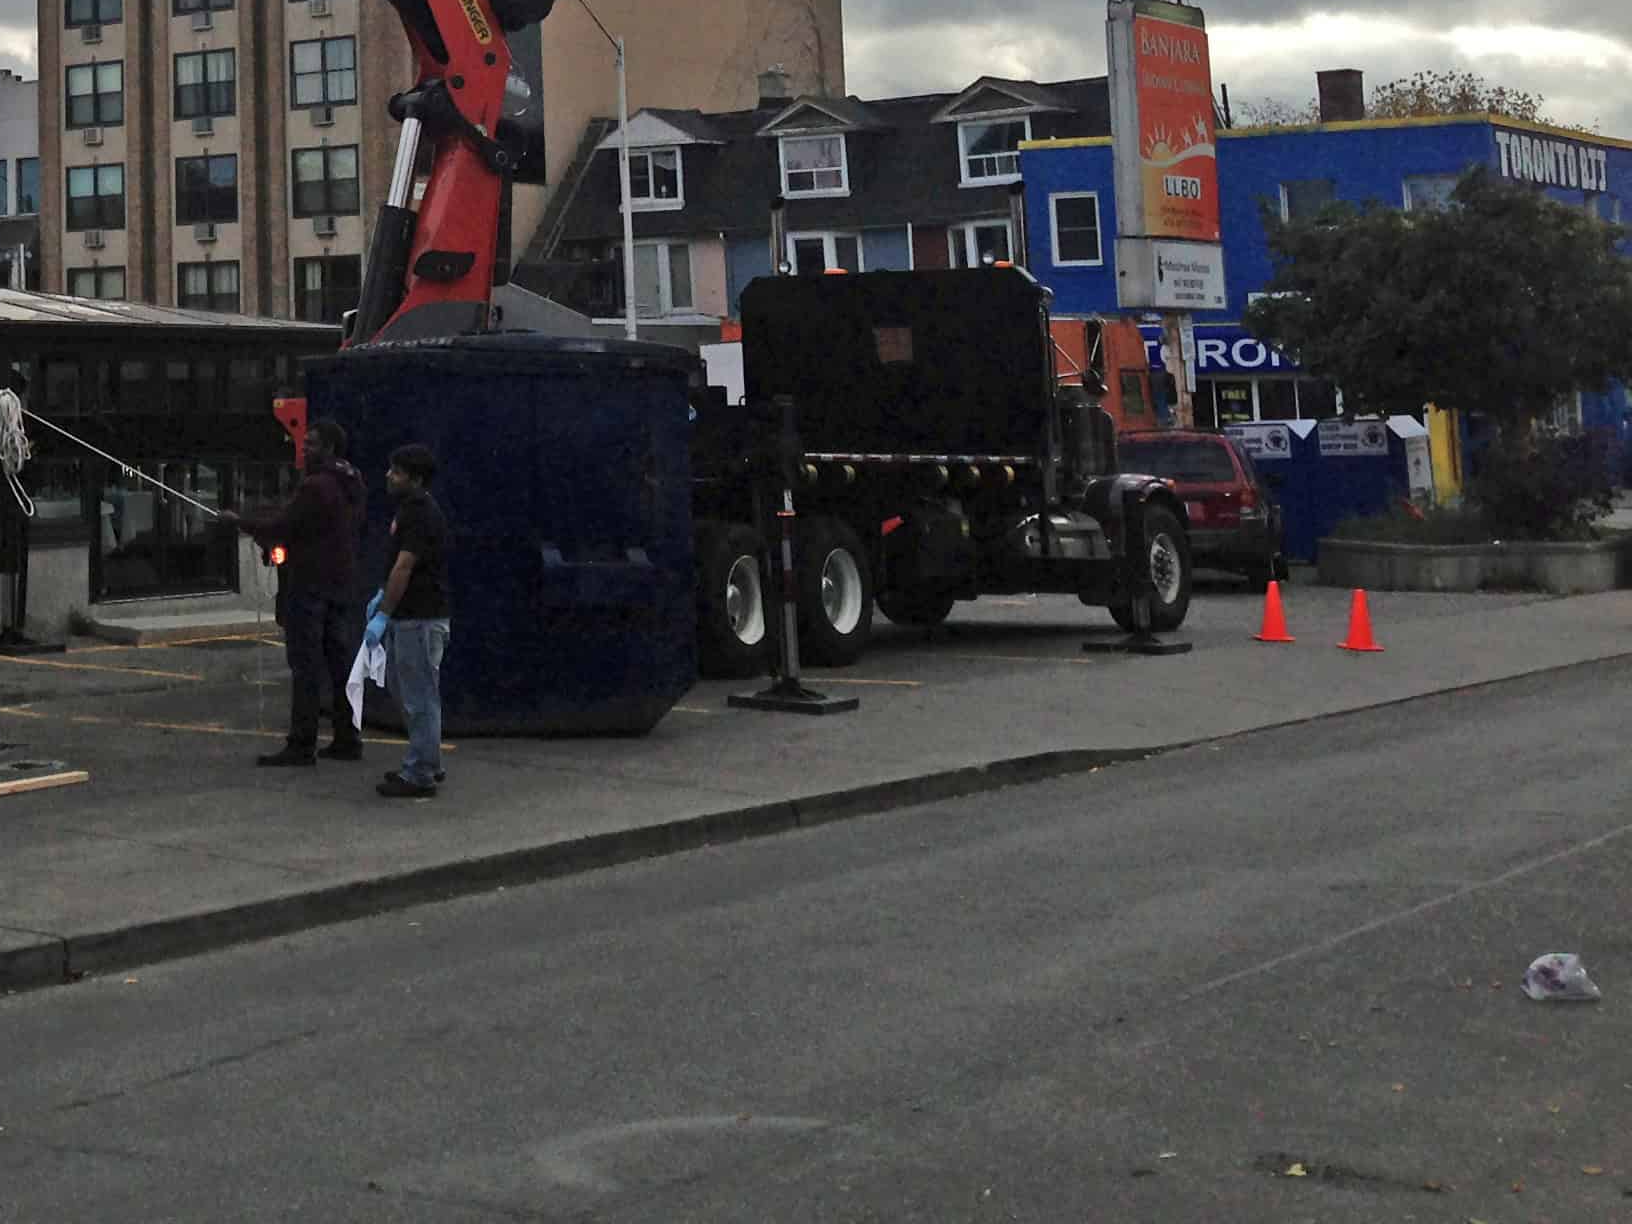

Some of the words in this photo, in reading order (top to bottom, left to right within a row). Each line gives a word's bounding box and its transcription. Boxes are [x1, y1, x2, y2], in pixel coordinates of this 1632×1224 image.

[1140, 26, 1201, 65] BANJARA
[1495, 131, 1578, 188] TORONTO
[1165, 177, 1200, 199] LLBO
